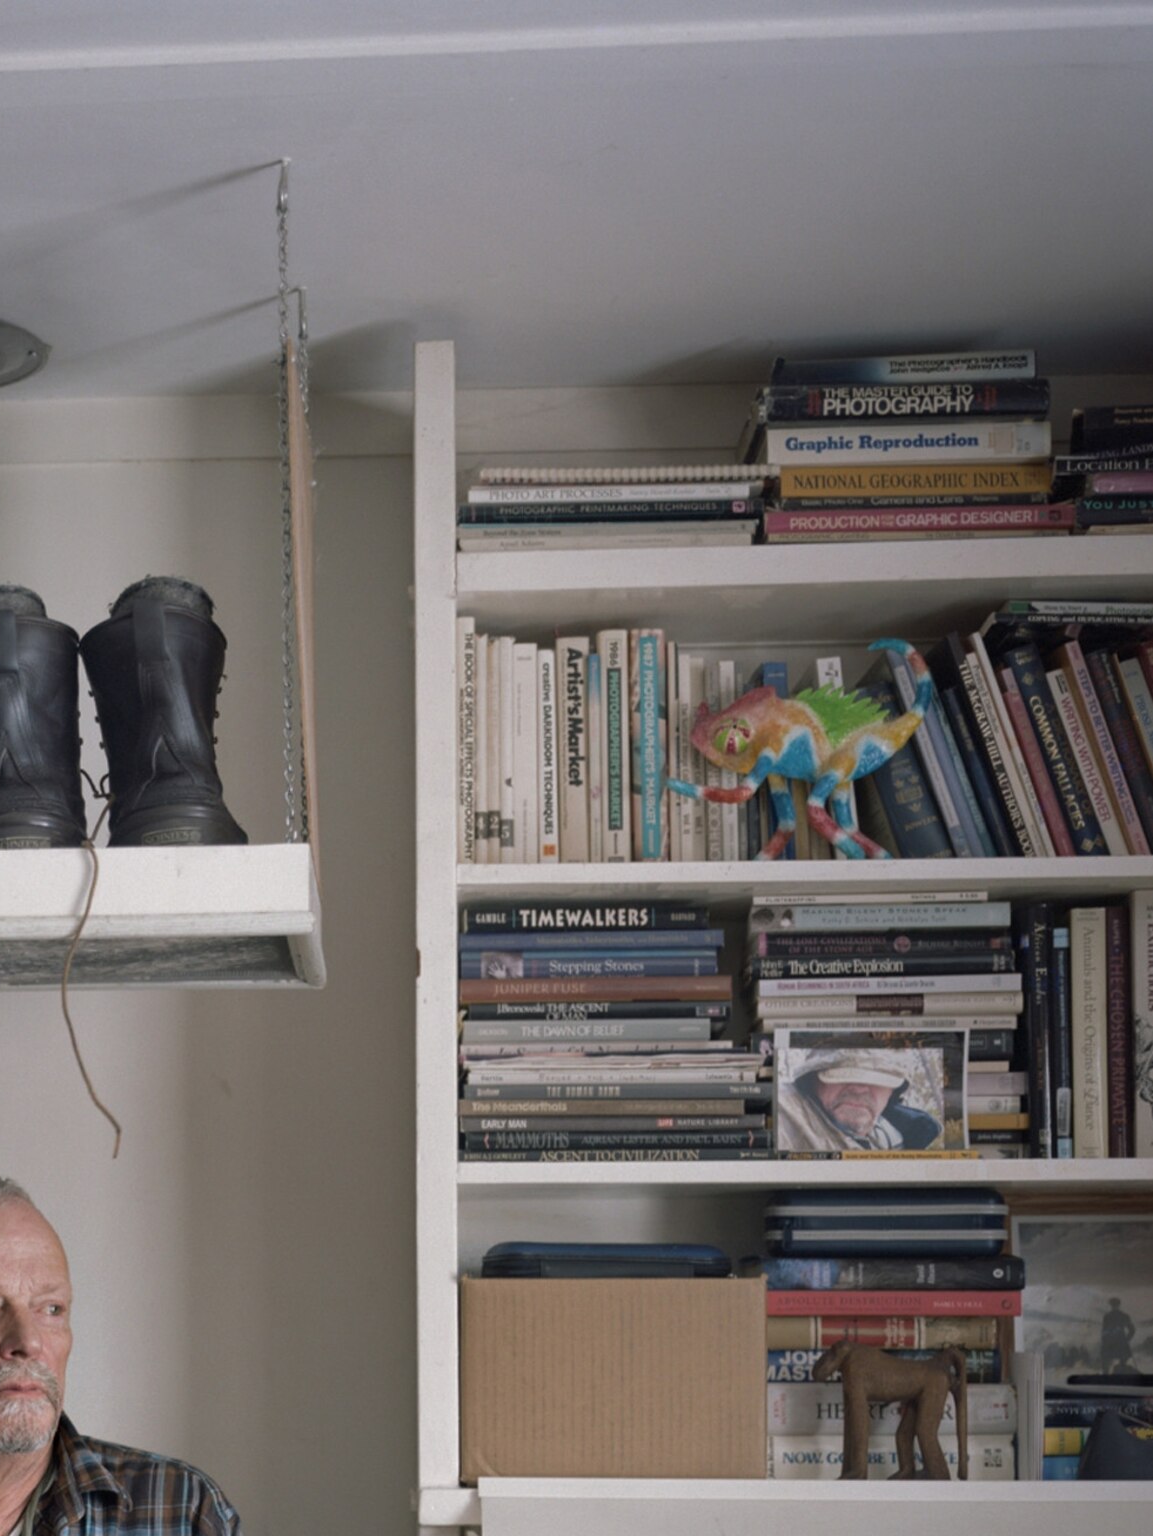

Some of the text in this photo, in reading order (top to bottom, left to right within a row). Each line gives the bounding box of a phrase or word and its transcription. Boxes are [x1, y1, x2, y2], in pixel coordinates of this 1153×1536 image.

[822, 384, 972, 399] THE MASTER GUIDE TO
[822, 395, 974, 417] PHOTOGRAPHY
[785, 433, 979, 454] Graphic Reproduction
[1066, 459, 1139, 471] Location
[793, 471, 1020, 490] NATIONAL GEOGRAPHIC INDEX
[489, 487, 622, 500] PHOTO ART PROCESSES
[871, 496, 913, 505] Camera
[937, 495, 964, 504] Lens
[499, 501, 717, 515] PHOTOGRAPHIC PRINTMAKING TECHNIQUES
[1083, 500, 1113, 510] YOU
[789, 509, 1033, 530] PRODUCTION GRAPHIC DESIGNER
[1062, 615, 1076, 623] and
[567, 647, 586, 787] Artist's Market
[609, 641, 621, 827] 1986 PHOTOGRAPHER'S MARKET
[643, 642, 656, 825] 1987 PHOTOGRAPHER'S MARKET
[1077, 668, 1130, 803] STEPS TO BETTER WRITING
[464, 633, 474, 861] THE BOOK OF SPECIAL EFFECTS PHOTOGRAPHY
[543, 662, 554, 834] creative DARKROOM TECHNIQUES
[959, 662, 971, 689] THE
[967, 688, 998, 770] McGRAW-HILL
[996, 770, 1023, 828] AUTHOR'S
[1029, 695, 1086, 830] COMMON FALLACIES
[1061, 697, 1111, 822] WRITING WITH POWER
[489, 816, 499, 829] 2
[501, 826, 510, 839] 5
[475, 907, 649, 928] GAMBLE TIMEWALKERS
[549, 958, 645, 975] Stepping Stones
[787, 957, 904, 977] The Creative Explosion
[1033, 921, 1046, 1006] African Exodus
[495, 981, 588, 998] JUNIPER FUSE
[546, 1002, 611, 1013] THE ASCENT
[764, 1000, 797, 1009] OTHER
[562, 1011, 588, 1021] MAN
[1111, 918, 1127, 1126] KUPER THE CHOSEN PRIMATE
[521, 1025, 625, 1037] THE DAWN OF BELIEF
[1080, 927, 1099, 1131] Animals and the Origins of Dance
[472, 1100, 568, 1112] The Neanderthals
[480, 1119, 507, 1130] EARLY
[507, 1119, 528, 1130] MAN
[708, 1118, 739, 1127] LIBRARY
[495, 1132, 570, 1149] MAMMOTHS
[581, 1135, 622, 1145] ADRIAN
[622, 1134, 661, 1144] LISTER
[662, 1133, 681, 1144] AND
[539, 1150, 590, 1161] ASCENT
[594, 1150, 612, 1161] TO
[613, 1149, 700, 1161] CIVILIZATION
[776, 1295, 921, 1306] ABSOLUTE DESTRUCTION
[779, 1350, 825, 1365] JOH
[816, 1402, 885, 1420] HERT
